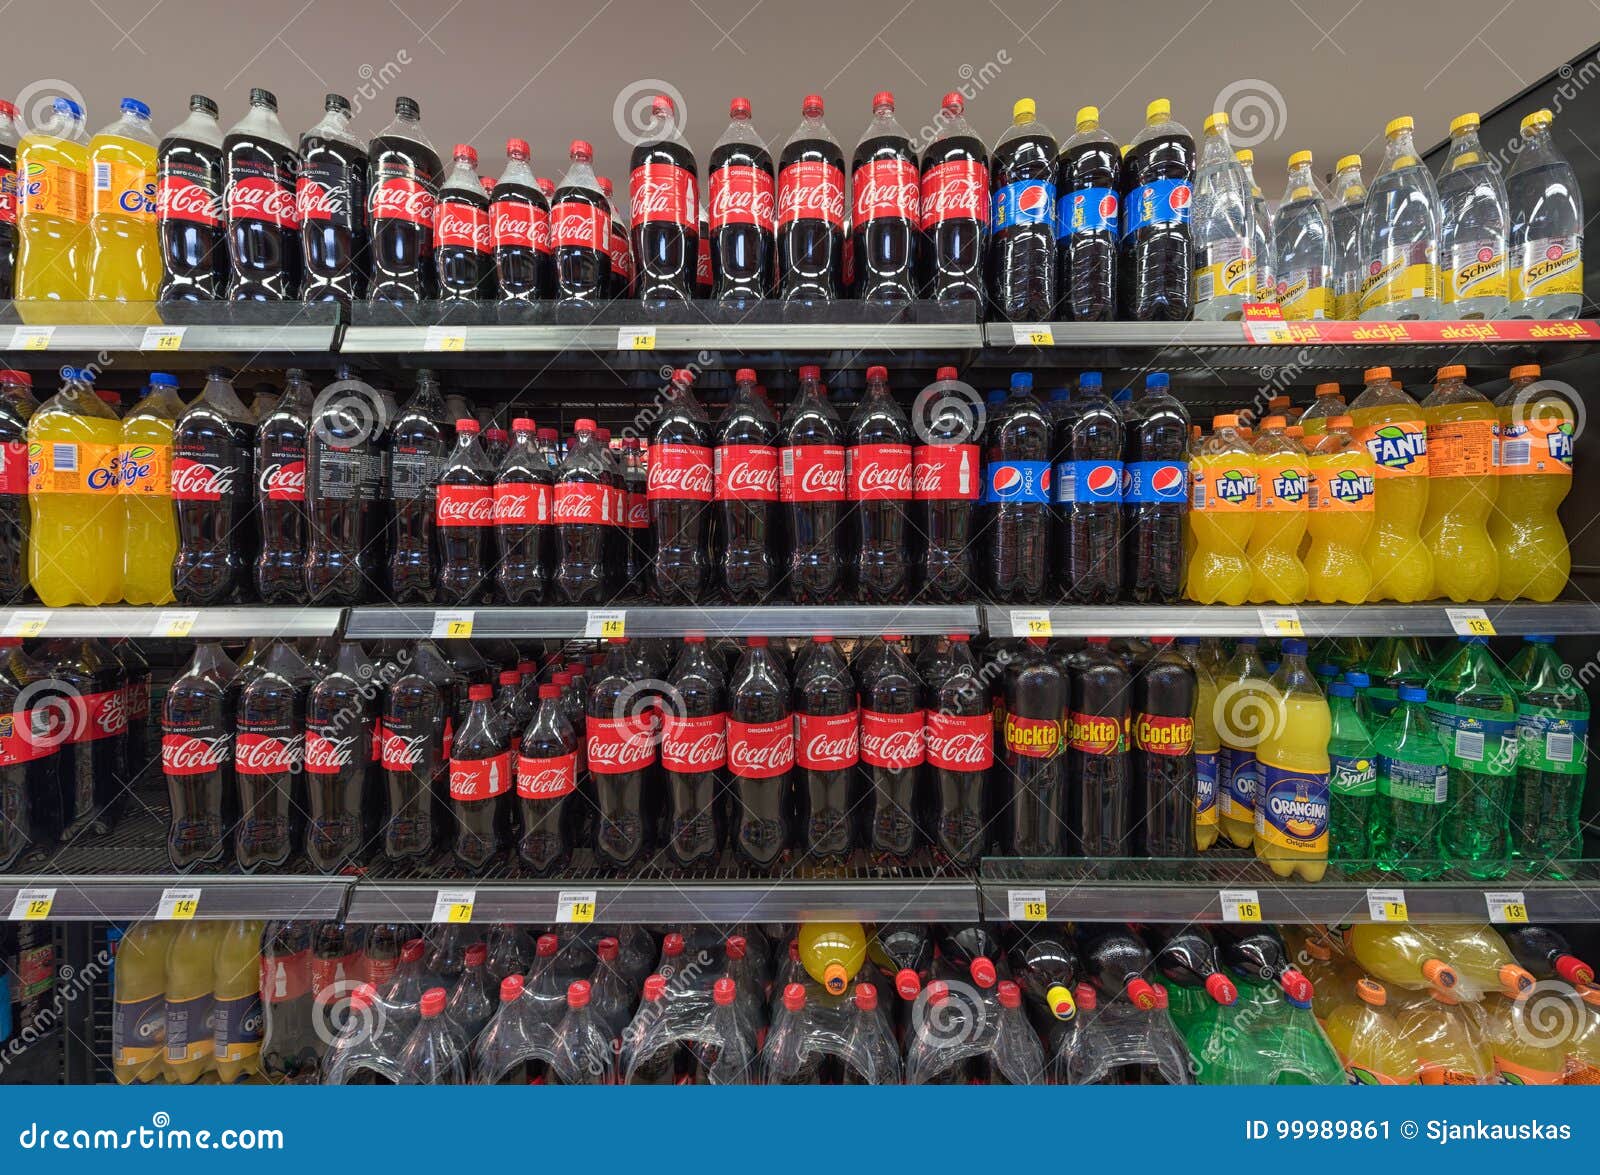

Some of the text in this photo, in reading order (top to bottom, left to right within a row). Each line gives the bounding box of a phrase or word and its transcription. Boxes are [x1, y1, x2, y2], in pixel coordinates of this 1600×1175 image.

[1247, 306, 1281, 318] akcija!
[1351, 324, 1409, 342] akcija!
[1439, 323, 1498, 341] akcija!
[1528, 322, 1588, 340] akcija!
[635, 336, 647, 345] 14
[1031, 334, 1044, 343] 12
[1024, 467, 1033, 496] pepsi
[1133, 467, 1143, 496] pepsi
[1216, 477, 1257, 498] FANT
[1273, 477, 1309, 498] FANT
[454, 623, 460, 633] 7
[604, 621, 617, 631] 14
[1469, 621, 1485, 632] 13
[1007, 722, 1057, 746] Cockta
[1068, 719, 1116, 743] Cockta
[1140, 722, 1193, 745] Cockta
[4, 754, 17, 762] 2L
[1270, 796, 1327, 820] ORANGINA
[1284, 837, 1317, 850] Original
[31, 901, 45, 912] 12
[177, 901, 191, 912] 14
[460, 905, 467, 918] 7
[574, 903, 587, 915] 14
[1028, 904, 1041, 915] 13
[1240, 905, 1253, 917] 16
[1391, 903, 1398, 915] 7
[1506, 906, 1521, 917] 13
